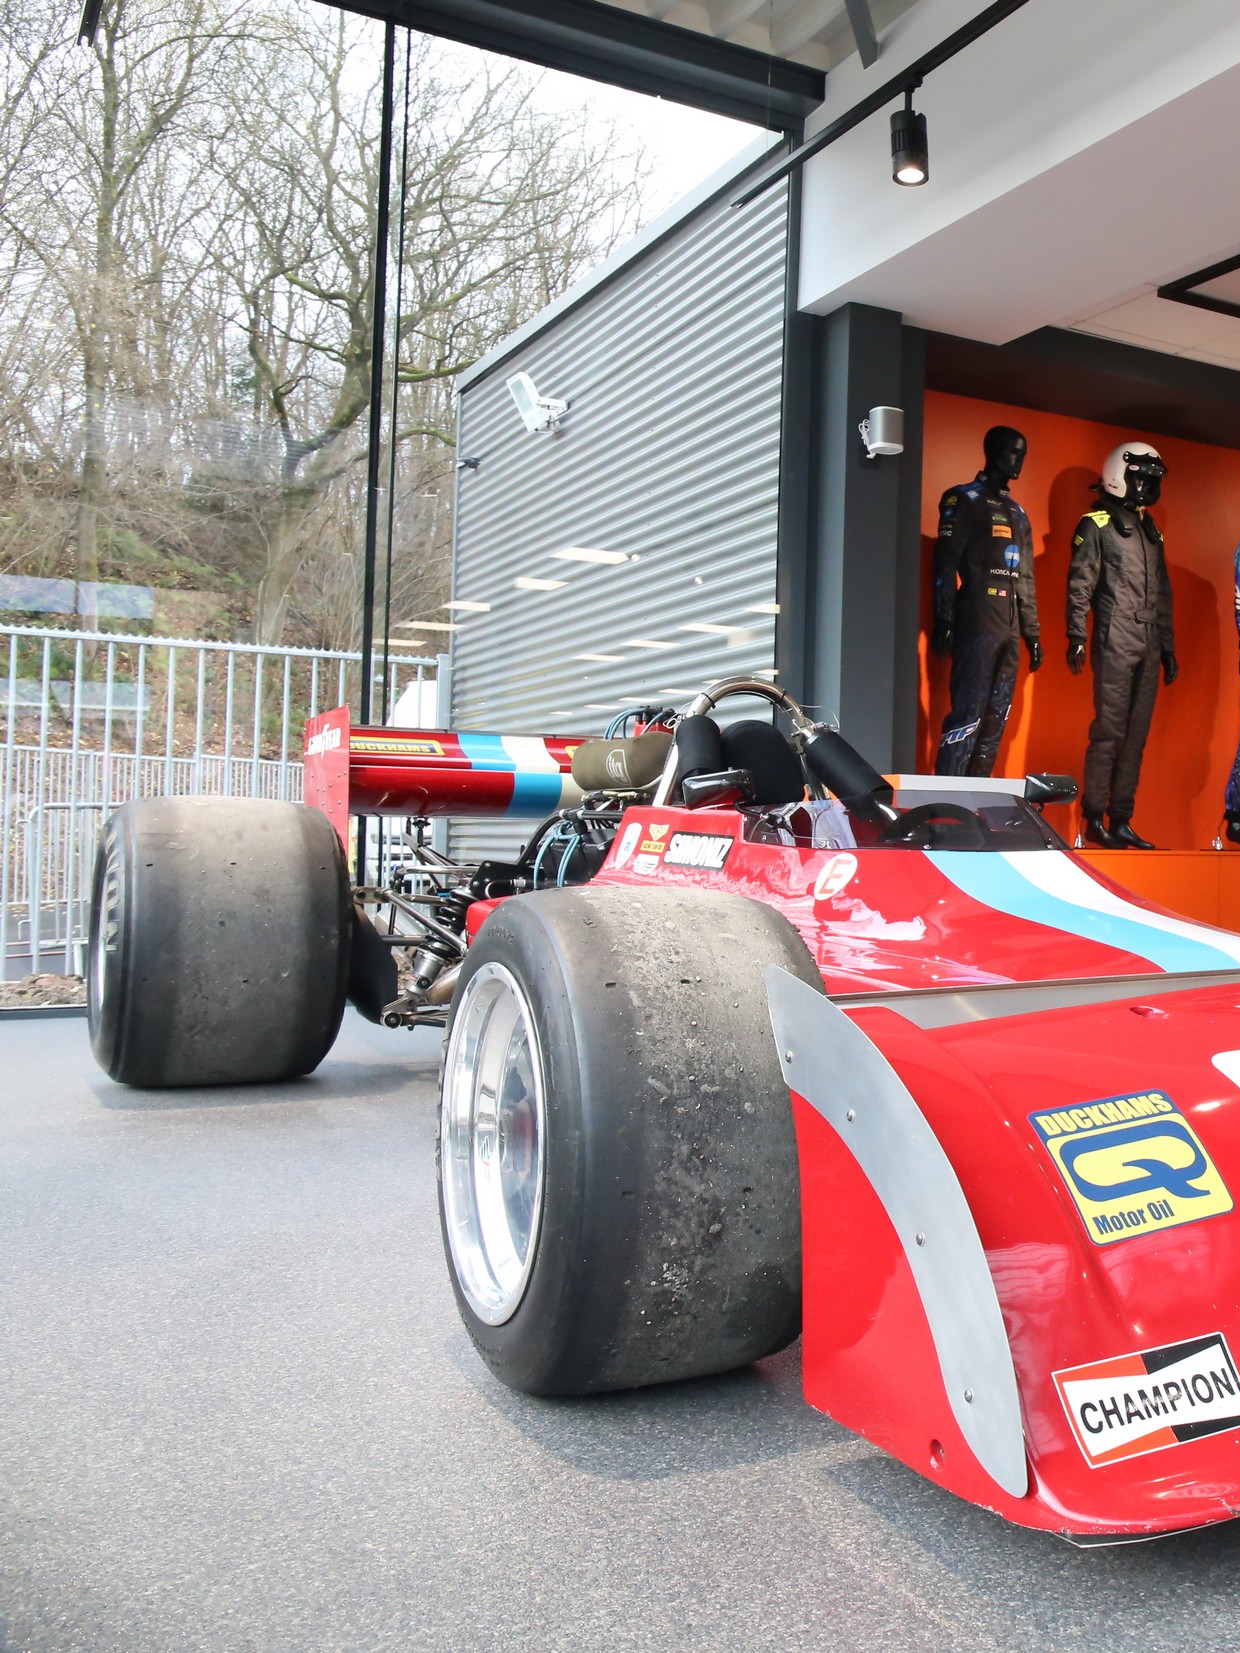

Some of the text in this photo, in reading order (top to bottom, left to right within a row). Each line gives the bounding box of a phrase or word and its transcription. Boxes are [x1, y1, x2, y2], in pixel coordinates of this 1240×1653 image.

[663, 833, 733, 869] SIMONIZ
[818, 858, 853, 895] E
[1035, 1093, 1173, 1136] DUCKHAMS
[1059, 1120, 1211, 1203] Q
[1092, 1199, 1175, 1235] Motor Oil
[1080, 1368, 1236, 1434] CHAMPION
